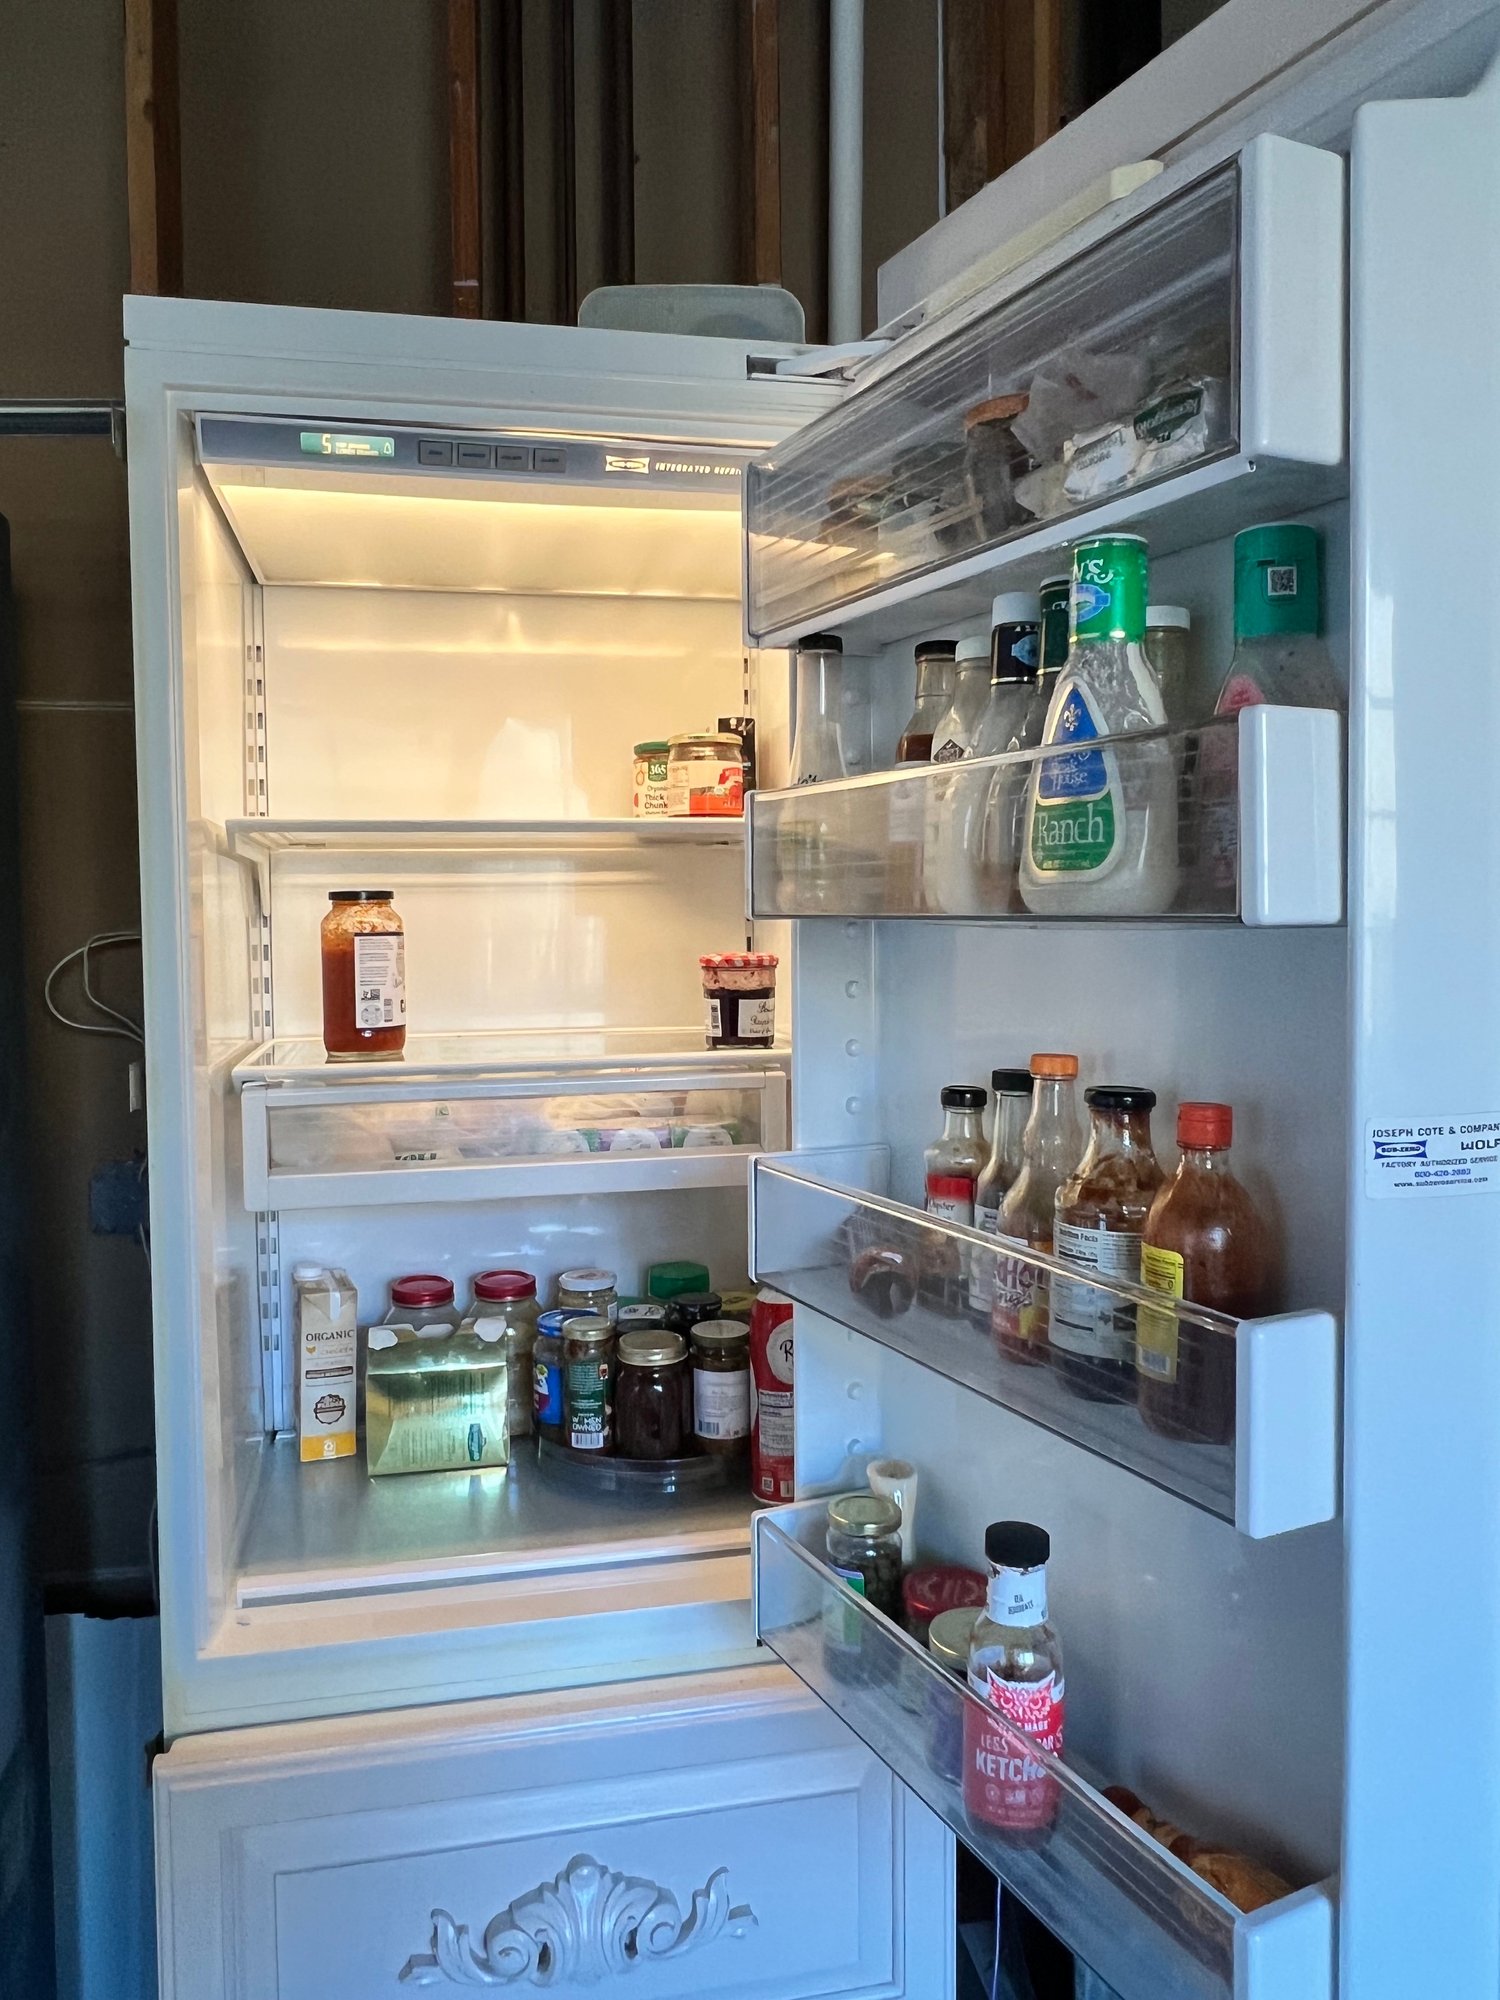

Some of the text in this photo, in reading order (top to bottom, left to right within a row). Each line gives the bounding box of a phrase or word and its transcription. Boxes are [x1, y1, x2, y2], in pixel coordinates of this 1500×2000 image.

[649, 764, 667, 775] 365
[645, 793, 665, 802] Thick
[644, 801, 669, 809] Chunk
[1037, 802, 1105, 846] Ranch
[1372, 1128, 1413, 1138] JOSEPH
[1417, 1126, 1444, 1136] COTE
[1448, 1126, 1457, 1135] &
[1381, 1160, 1417, 1169] FACTORY
[305, 1329, 355, 1342] ORGANIC
[975, 1746, 1047, 1783] KETCH
